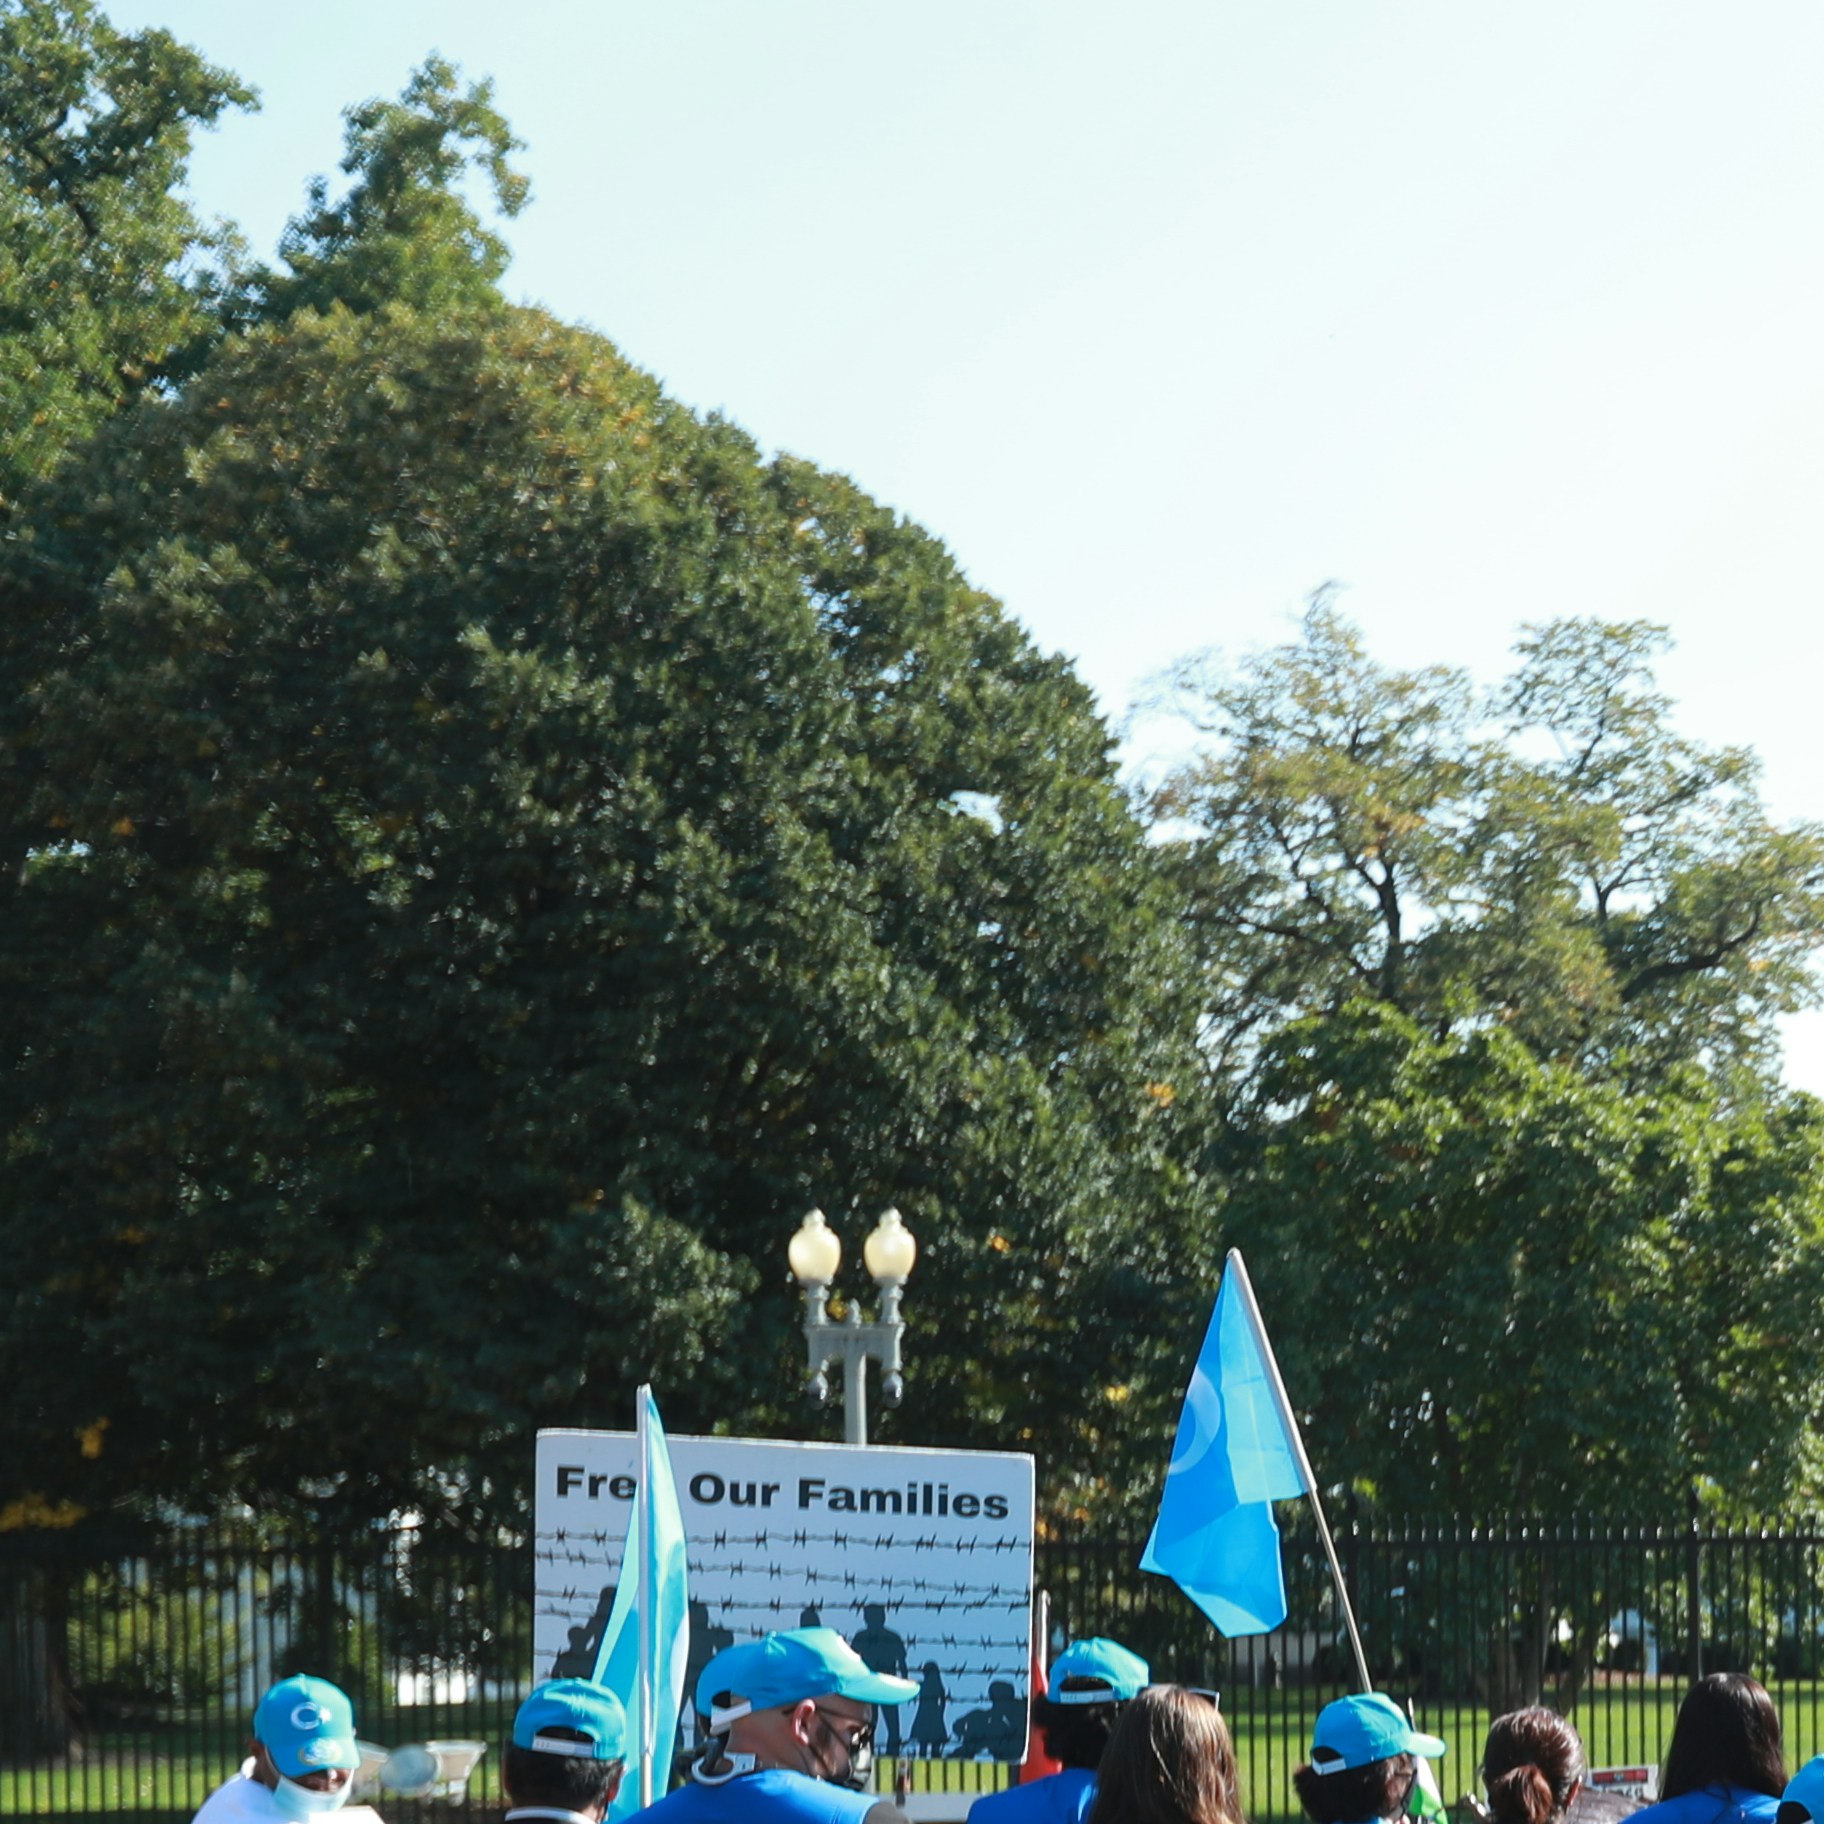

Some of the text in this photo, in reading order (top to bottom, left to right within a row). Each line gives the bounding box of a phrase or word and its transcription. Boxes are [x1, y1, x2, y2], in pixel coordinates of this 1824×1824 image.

[556, 1465, 1010, 1520] Fre Our Families
